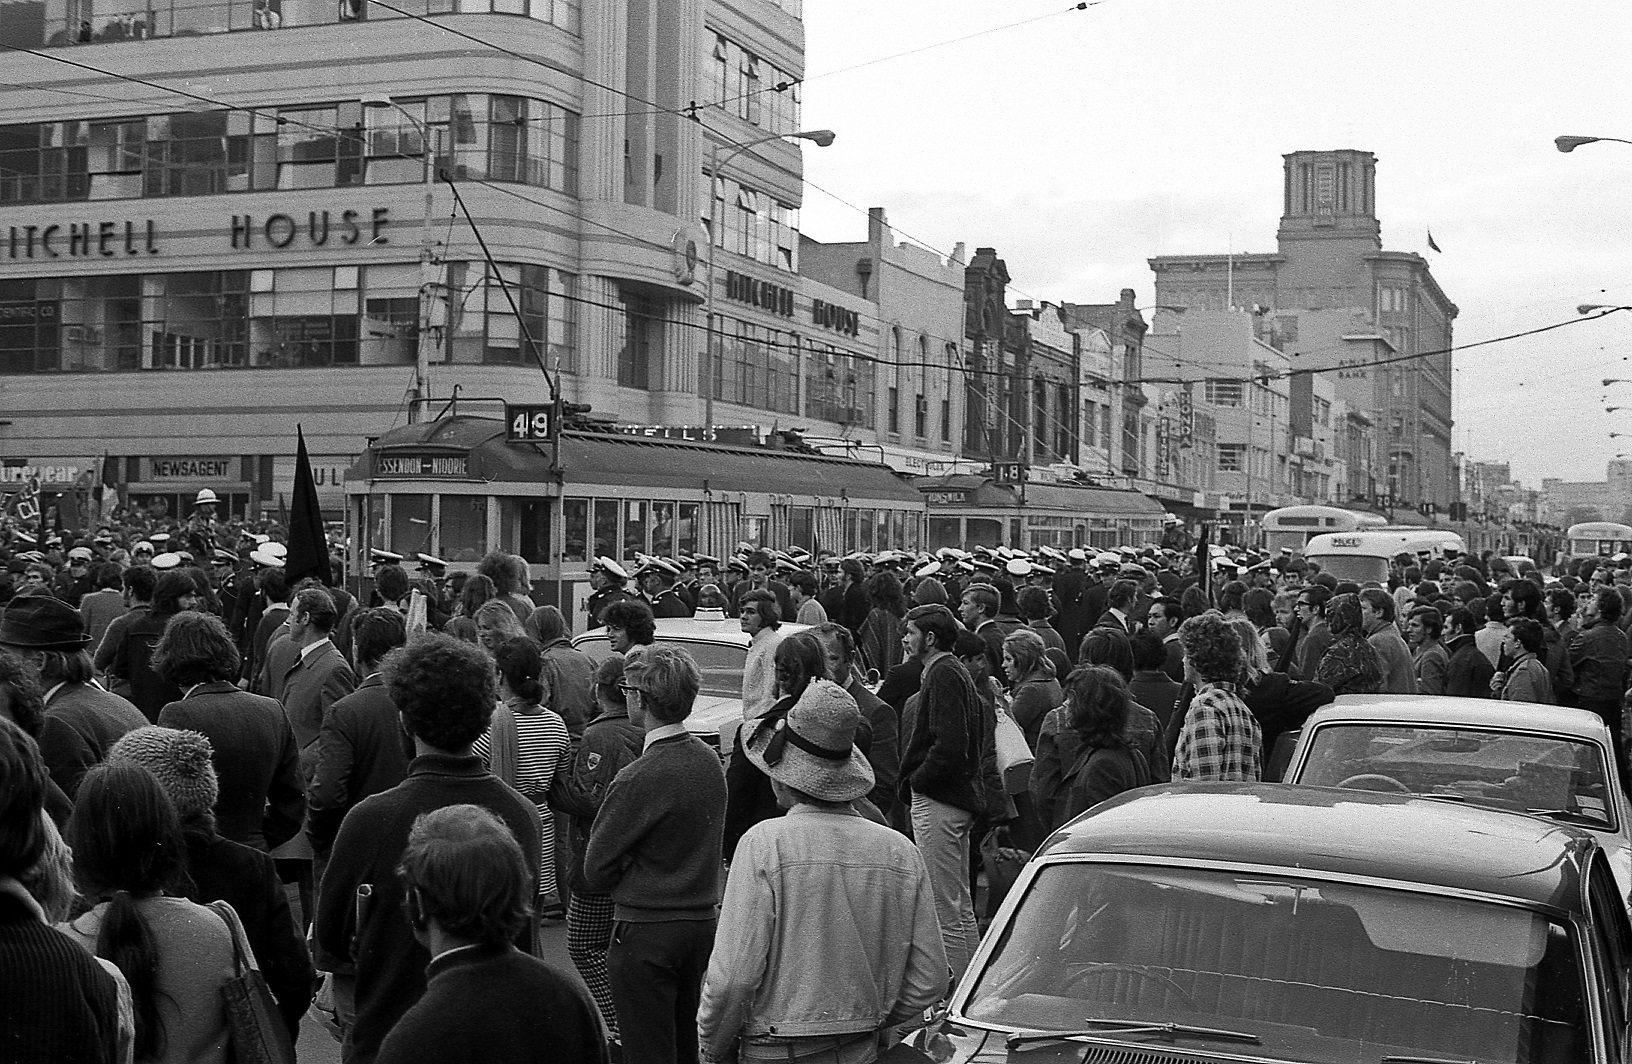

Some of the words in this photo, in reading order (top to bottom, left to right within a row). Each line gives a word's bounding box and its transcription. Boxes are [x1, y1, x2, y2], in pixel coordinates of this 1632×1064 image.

[231, 207, 389, 249] HOUSE
[513, 411, 548, 438] 49
[1180, 392, 1192, 448] HONDA
[154, 461, 230, 476] NEWSAGENT
[1000, 465, 1018, 481] 18
[1377, 497, 1390, 507] 20
